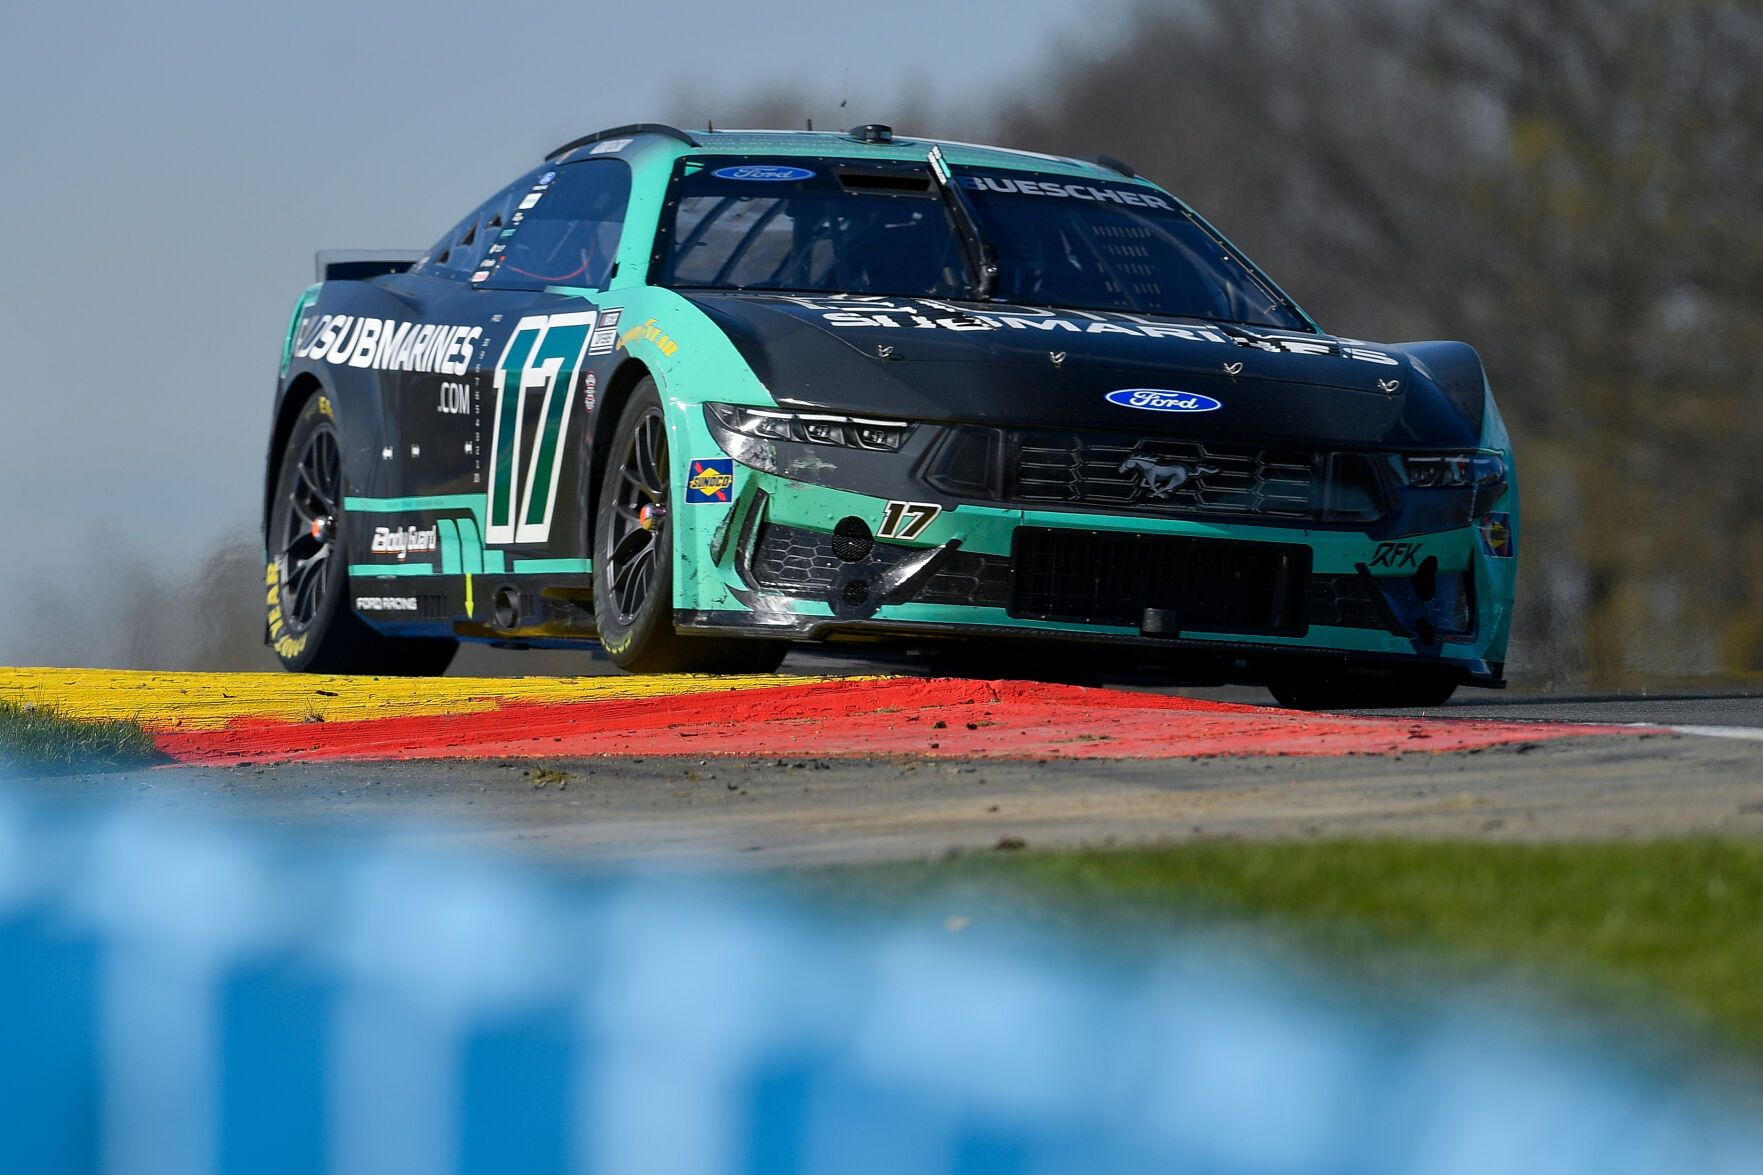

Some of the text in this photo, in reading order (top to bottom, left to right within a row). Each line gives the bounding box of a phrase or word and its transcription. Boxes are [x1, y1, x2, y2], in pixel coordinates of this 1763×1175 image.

[733, 167, 793, 179] Ford
[959, 175, 1175, 211] BUESCHER
[437, 382, 470, 415] .COM
[1129, 390, 1199, 411] Ford
[485, 310, 598, 545] 17
[690, 474, 732, 488] SUNOCO
[877, 500, 942, 540] 17
[1368, 543, 1424, 567] RFK
